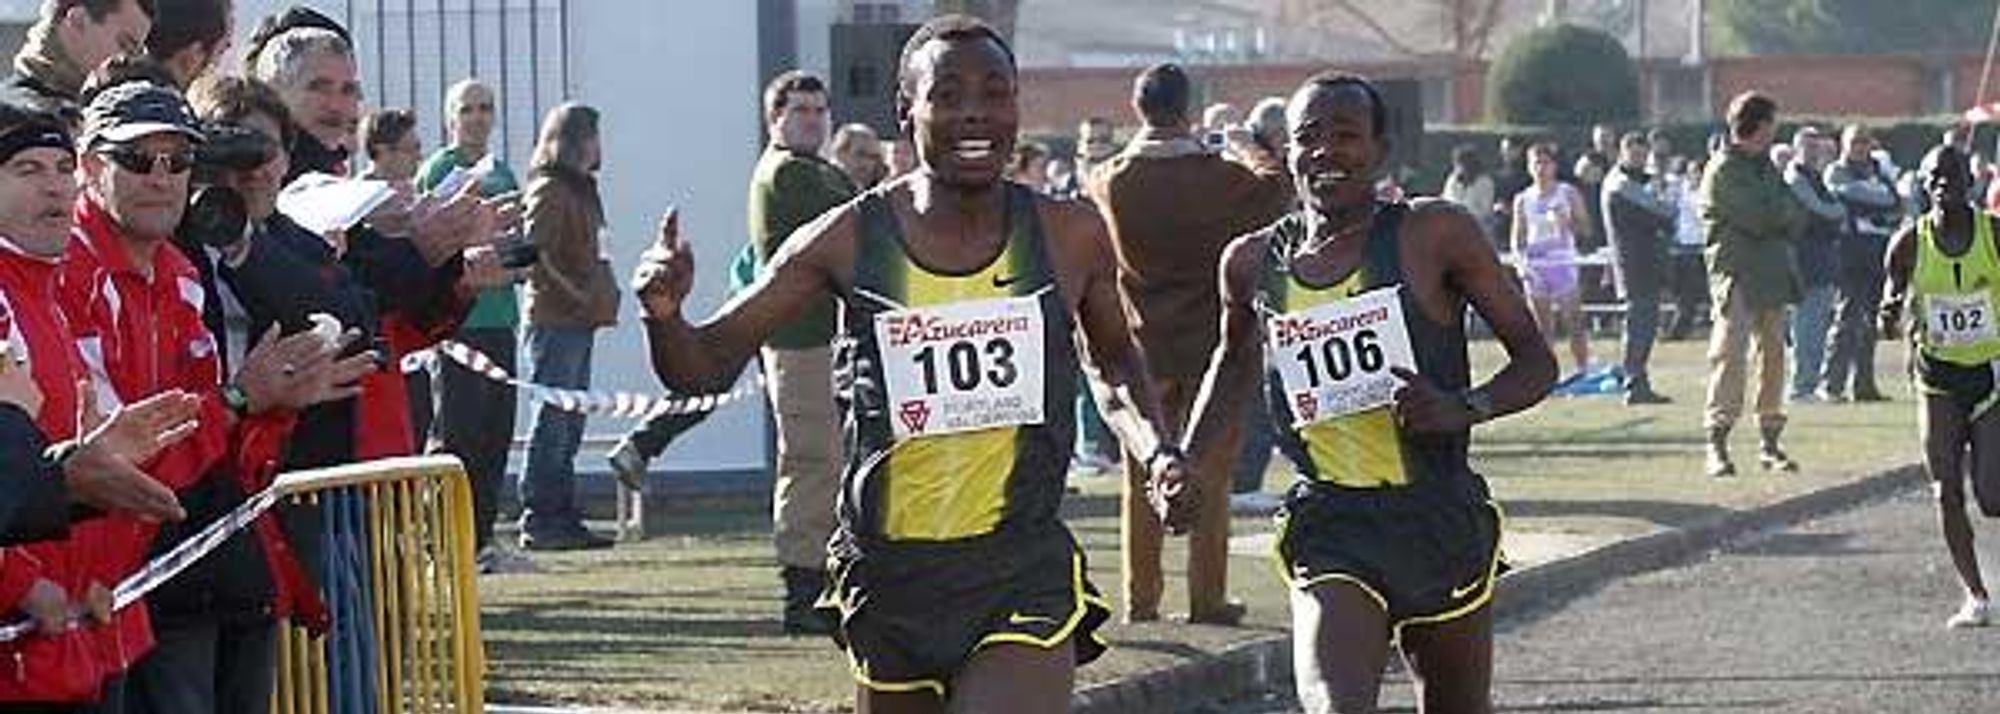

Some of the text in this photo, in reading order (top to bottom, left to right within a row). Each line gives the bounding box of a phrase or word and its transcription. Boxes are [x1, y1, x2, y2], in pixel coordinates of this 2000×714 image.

[1940, 310, 1982, 331] 102
[913, 338, 1017, 394] 103
[1297, 330, 1384, 387] 106
